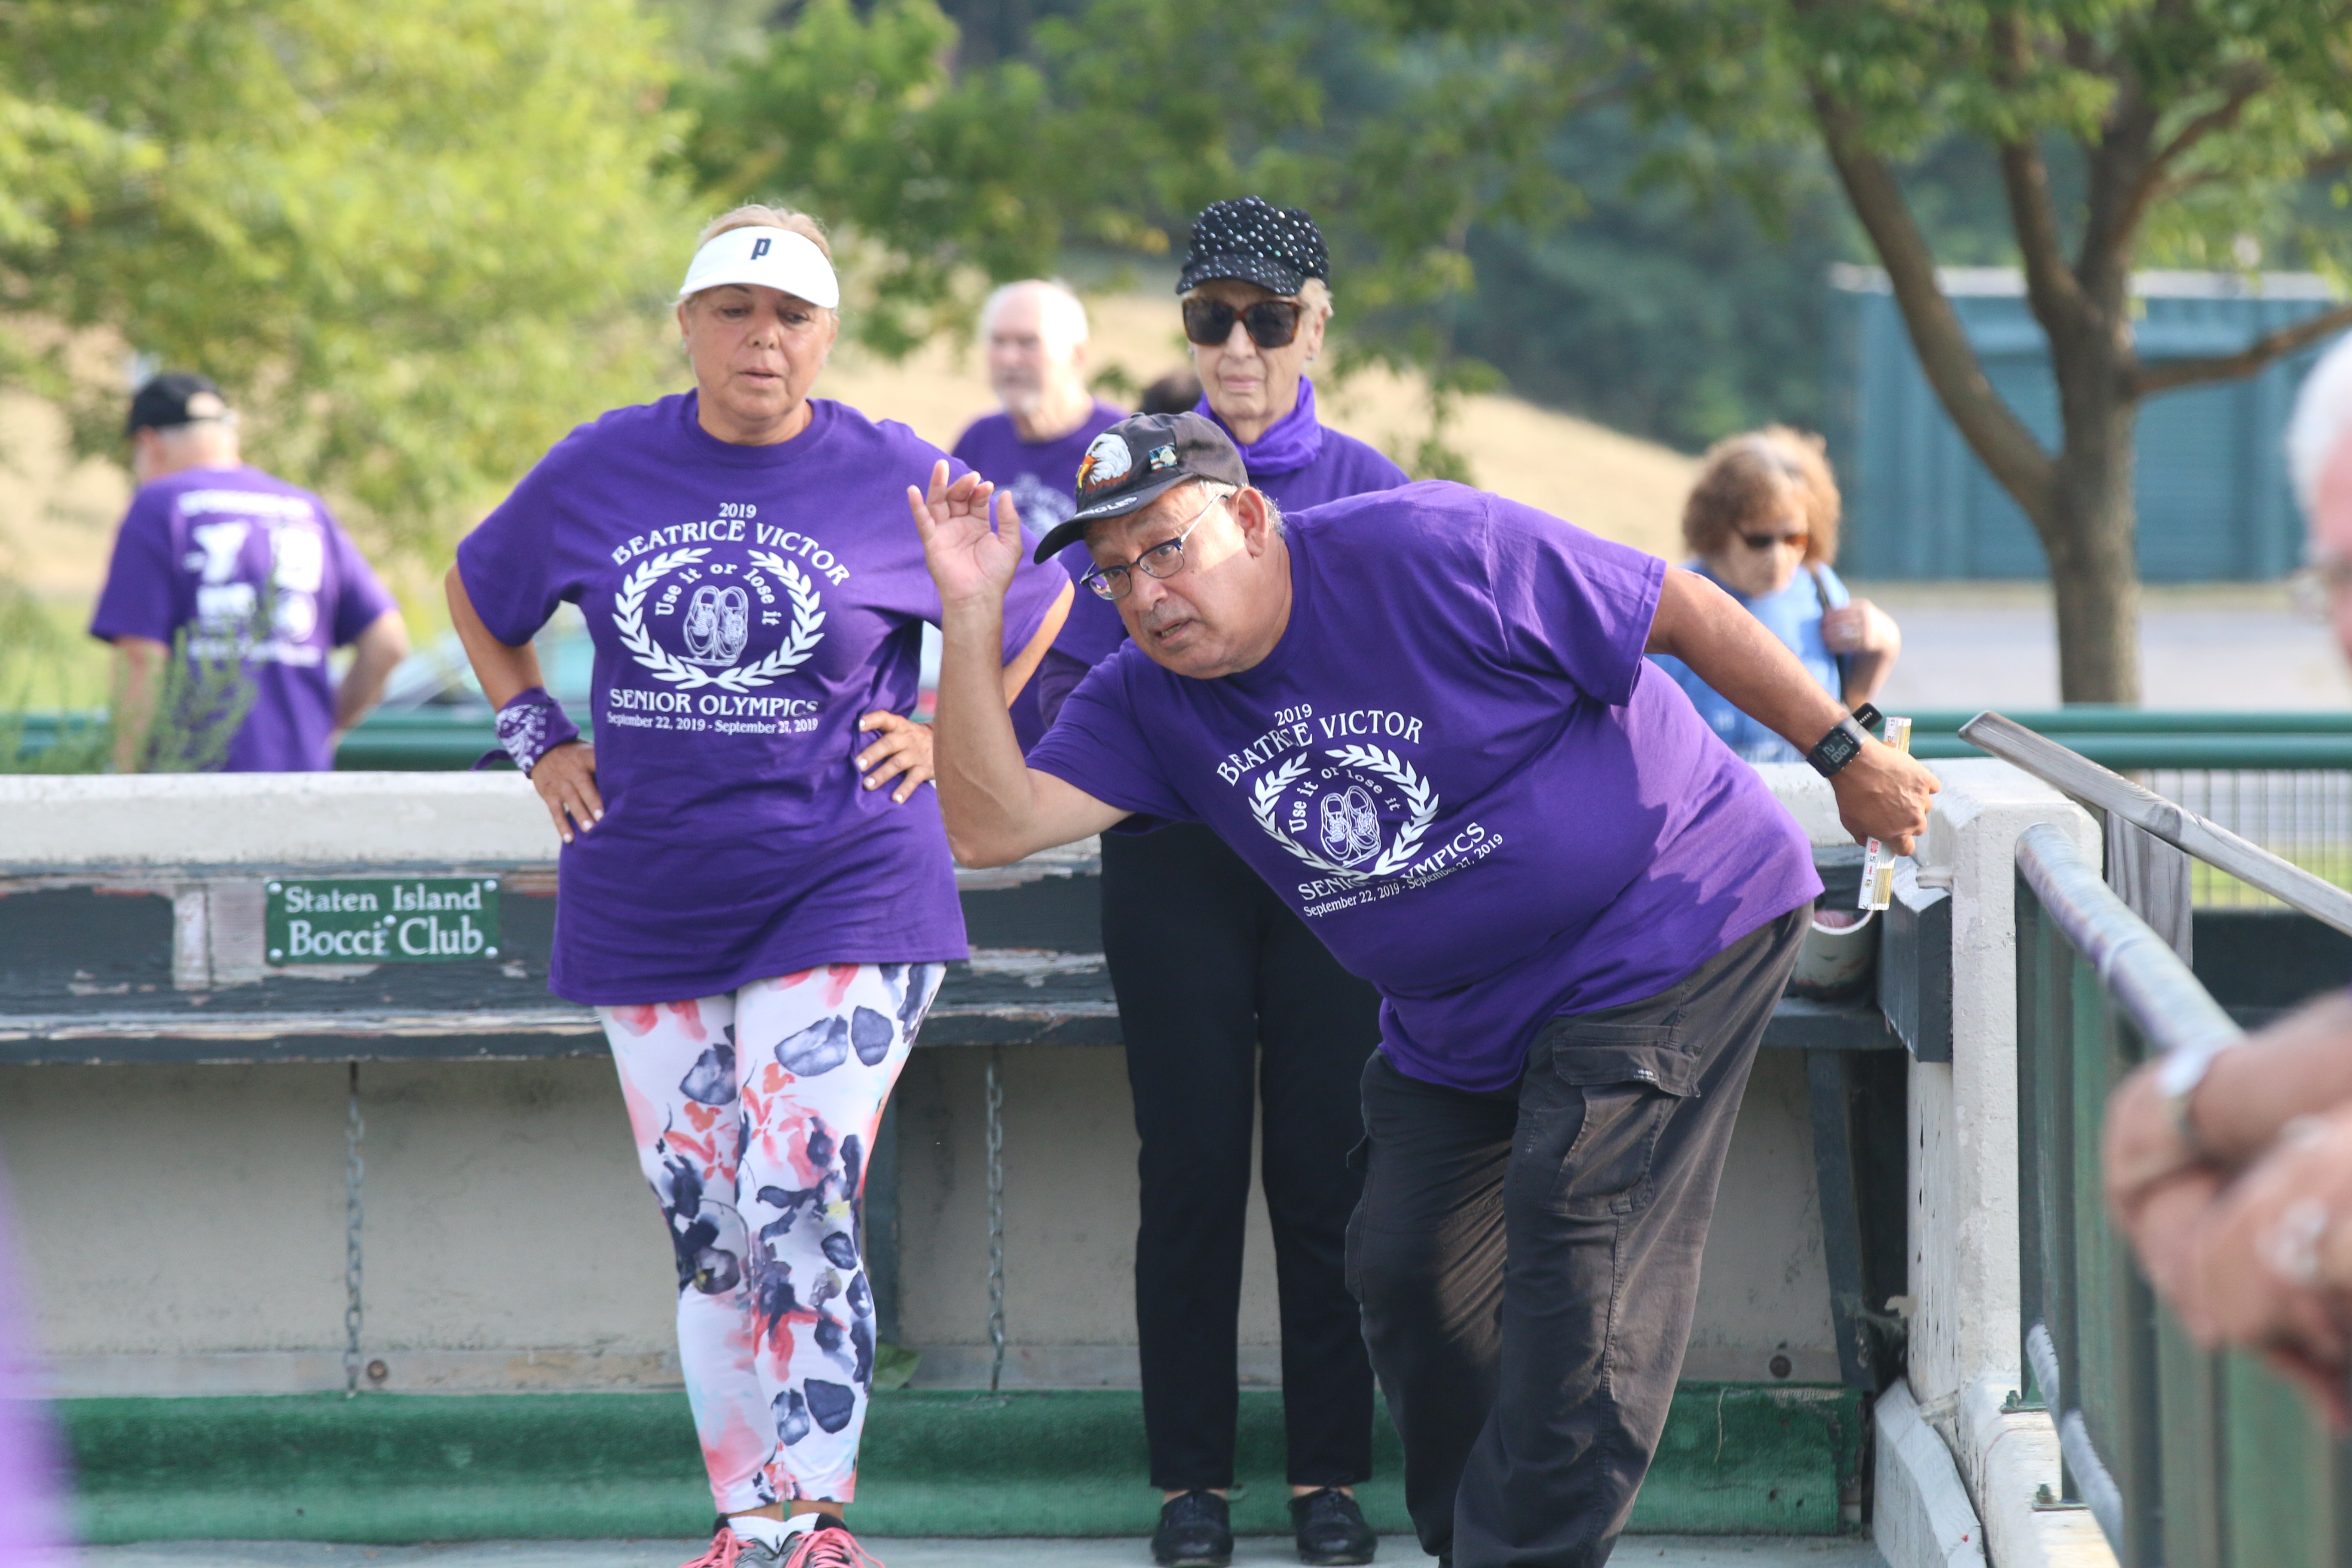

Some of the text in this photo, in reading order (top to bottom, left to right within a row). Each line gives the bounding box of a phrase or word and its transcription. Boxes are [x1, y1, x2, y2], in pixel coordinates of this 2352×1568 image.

[719, 502, 756, 519] 2019
[611, 519, 850, 586] BEATRICE VICTOR
[655, 563, 782, 626] Use it or lose it
[609, 688, 818, 717] SENIOR OLYMPICS
[1274, 704, 1312, 726] 2019
[606, 711, 653, 728] September
[655, 715, 673, 730] 22,
[675, 717, 706, 732] 2019
[714, 720, 776, 736] September
[793, 718, 818, 733] 2019
[1320, 710, 1423, 744] VICTOR
[1297, 781, 1319, 797] it
[1384, 798, 1401, 811] it
[1289, 801, 1308, 833] Use
[1303, 895, 1357, 917] September
[1359, 890, 1376, 903] 22,
[1377, 882, 1400, 899] 2019
[1456, 856, 1475, 869] 27,
[1474, 833, 1504, 859] 2019
[285, 882, 482, 913] Staten Island
[288, 915, 484, 957] Bocci Club
